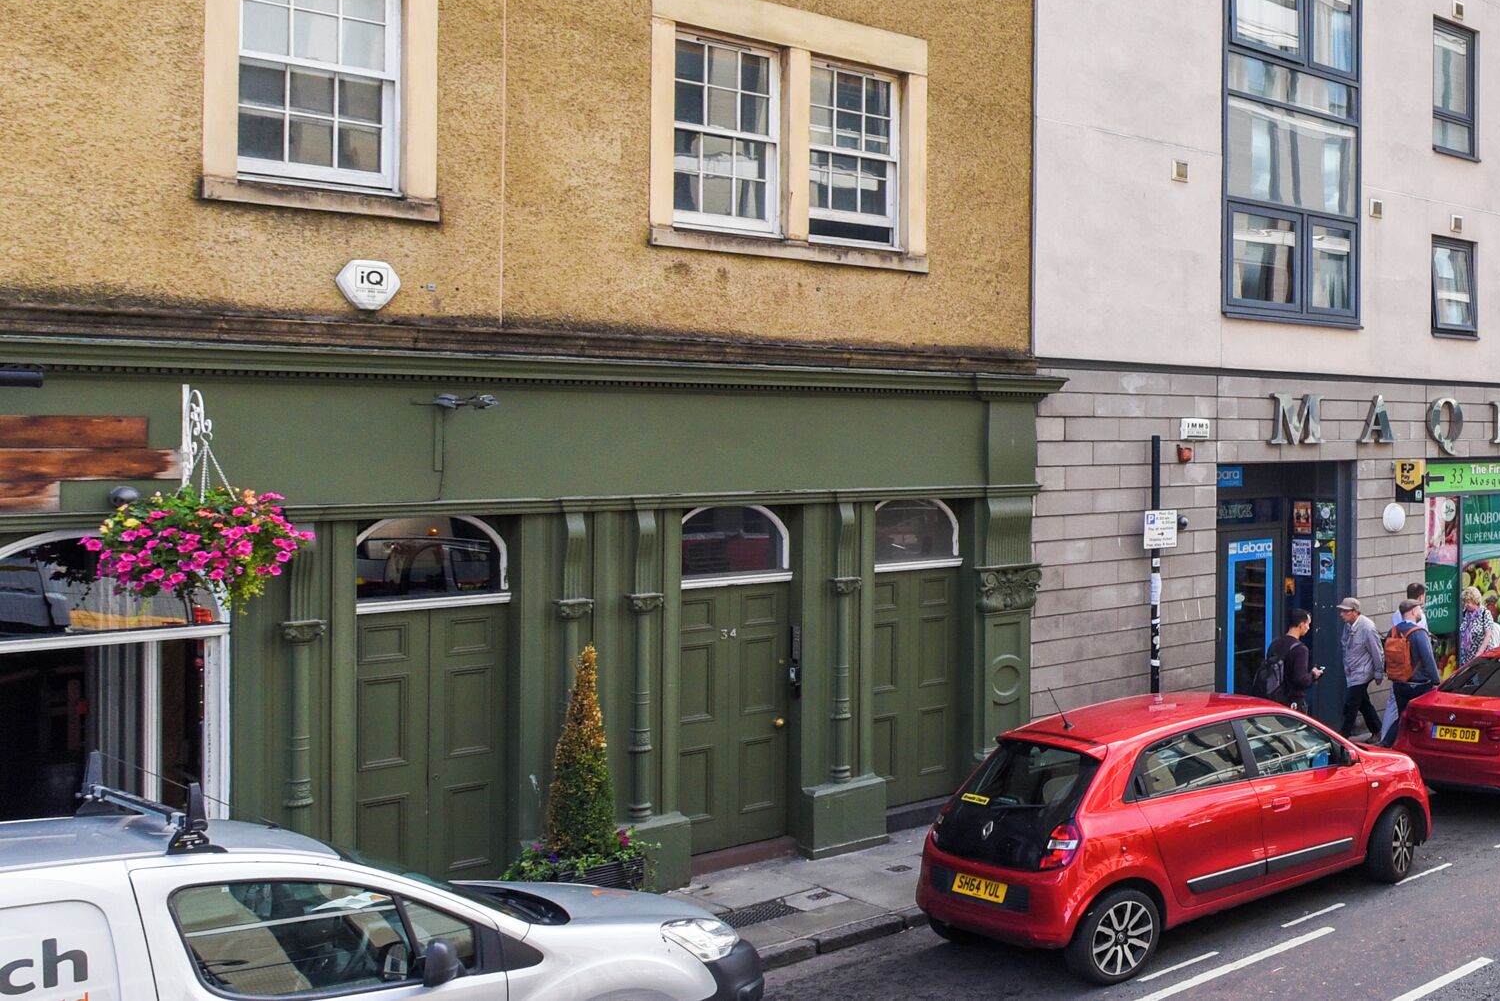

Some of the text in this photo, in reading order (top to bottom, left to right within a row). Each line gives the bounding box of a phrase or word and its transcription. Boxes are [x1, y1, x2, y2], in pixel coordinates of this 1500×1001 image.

[361, 270, 384, 286] iQ
[1470, 464, 1486, 474] The
[1400, 478, 1415, 486] Point
[1401, 474, 1410, 482] Pay
[1450, 468, 1464, 485] 33
[1237, 541, 1272, 554] Lebara
[1446, 579, 1453, 590] &
[720, 628, 737, 639] 34
[1438, 727, 1458, 739] CP16
[957, 875, 1001, 899] SH64 YUL
